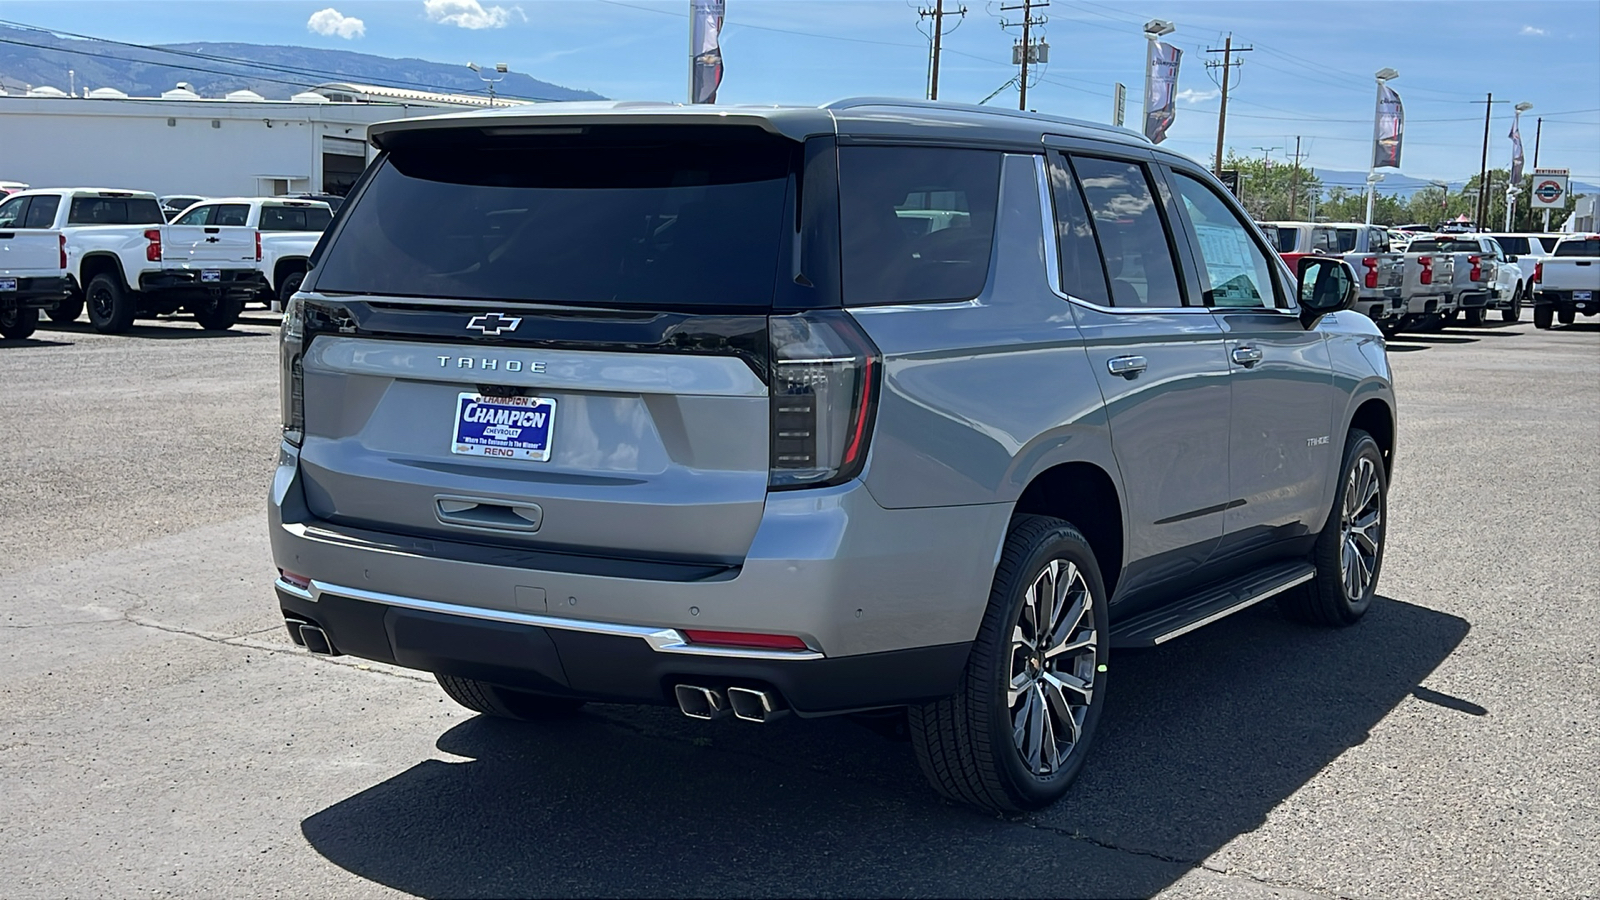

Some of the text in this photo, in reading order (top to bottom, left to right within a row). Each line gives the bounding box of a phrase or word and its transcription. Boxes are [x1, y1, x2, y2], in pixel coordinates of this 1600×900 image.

[437, 356, 547, 373] TAHOE
[483, 396, 529, 406] CHAMPION
[463, 403, 546, 428] CHAMPION
[486, 428, 519, 436] CHEVROLET
[484, 447, 514, 457] RENO
